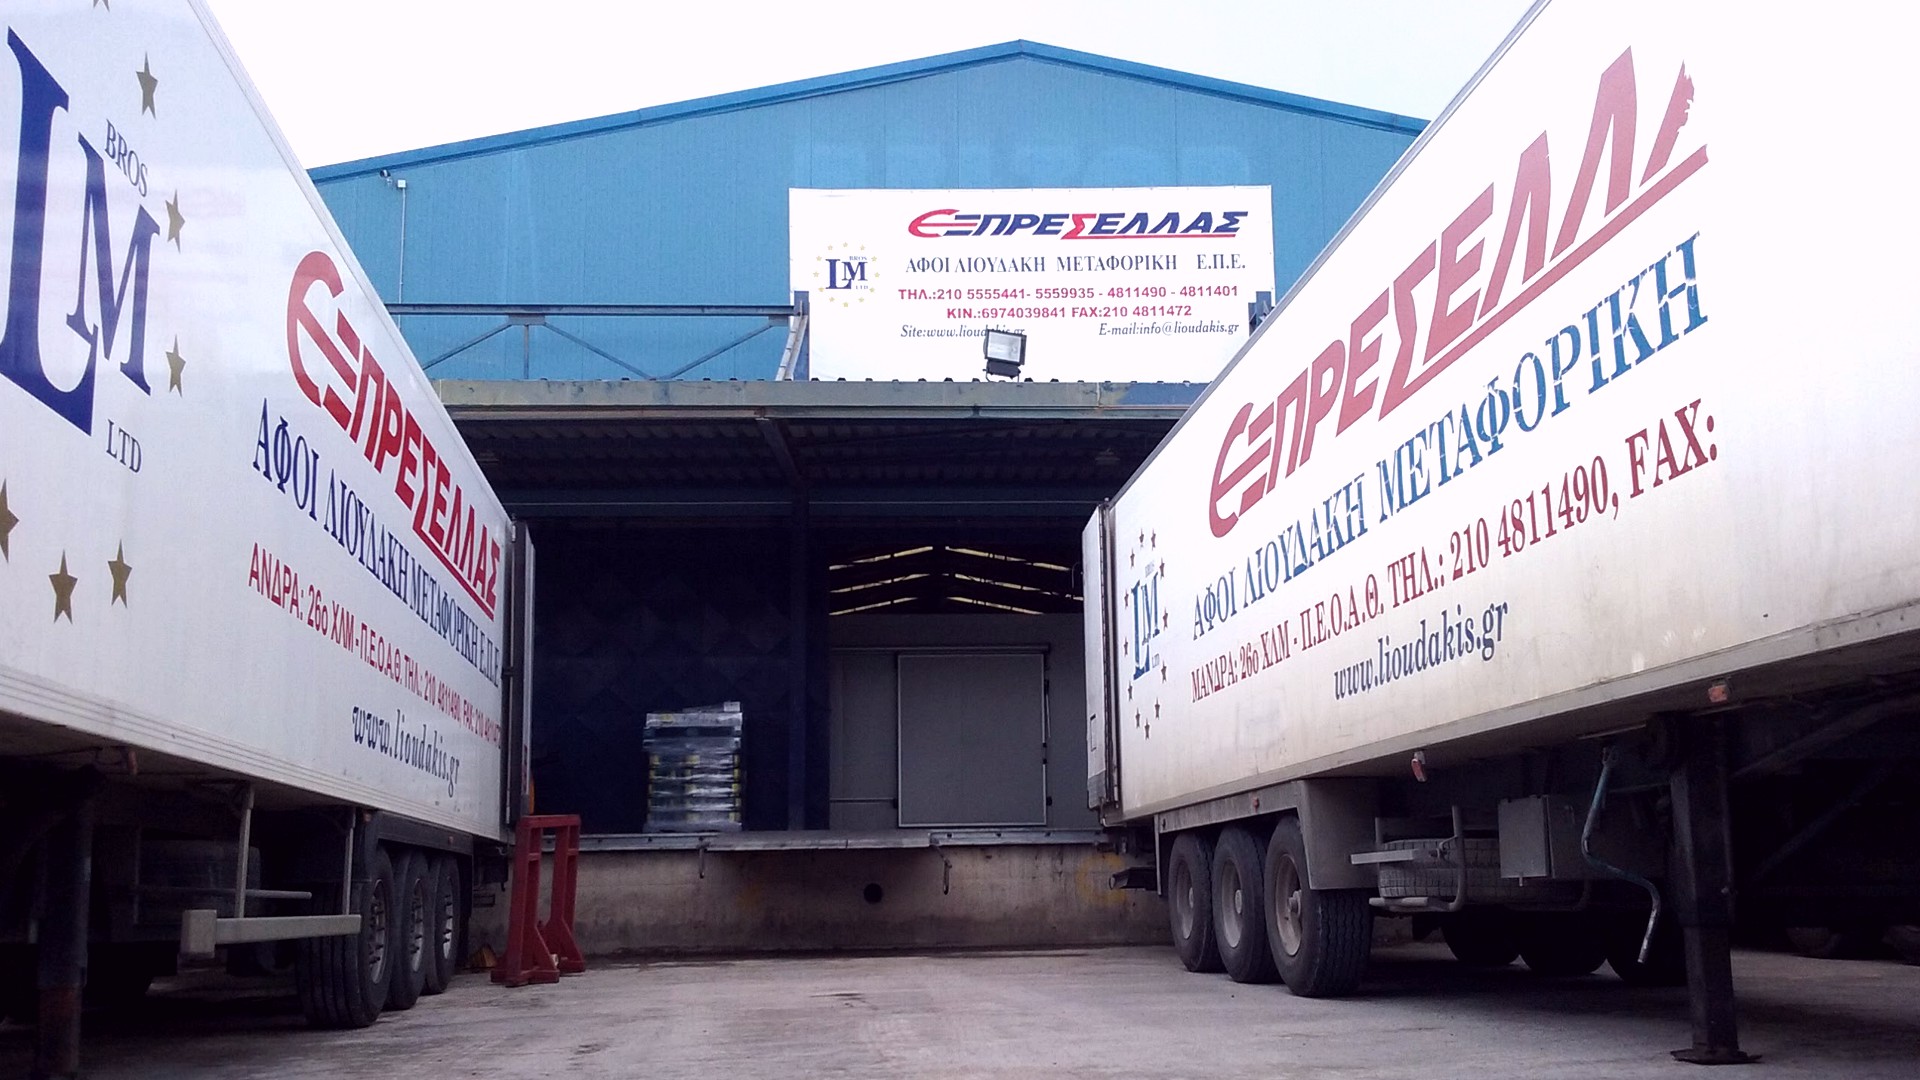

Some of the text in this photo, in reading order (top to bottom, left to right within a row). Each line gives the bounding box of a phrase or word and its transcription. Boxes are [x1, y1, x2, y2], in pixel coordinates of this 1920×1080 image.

[104, 119, 149, 197] BROS
[825, 259, 868, 289] LM
[906, 253, 1246, 273] ΑΦΟΙ ΛΙΟΥΔΑΚΗ ΜΕΤΑΦΟΡΙΚΗ Ε.Π.Ε.
[1035, 287, 1095, 299] 5559935
[1107, 287, 1166, 298] 4811490
[1179, 286, 1238, 297] 4811401
[1098, 321, 1240, 336] E-mail:info@lioudakis.gr
[1132, 305, 1192, 317] 4811472
[106, 419, 142, 473] LTD
[1193, 231, 1708, 641] ΑΦΟΙ ΛΙΟΥΔΑΚΗ ΜΕΤΑΦΟΡΙΚΗ
[253, 398, 320, 521] ΑΦΟΙ
[323, 468, 409, 605] ΛΙΟΥΔΑΚΗ
[409, 557, 479, 669] ΜΕΤΑΦΟΡΙΚΗ
[1191, 650, 1238, 703] ΜΑΝΔΡΑ:
[1260, 620, 1291, 670] ΧΛΜ
[1450, 517, 1489, 581] 210
[1625, 398, 1718, 499] FAX:
[331, 600, 354, 653] ΧΛΜ
[424, 670, 436, 706] 210
[1334, 602, 1508, 701] www.lioudakis.gr
[352, 706, 460, 798] www.lioudakis.gr
